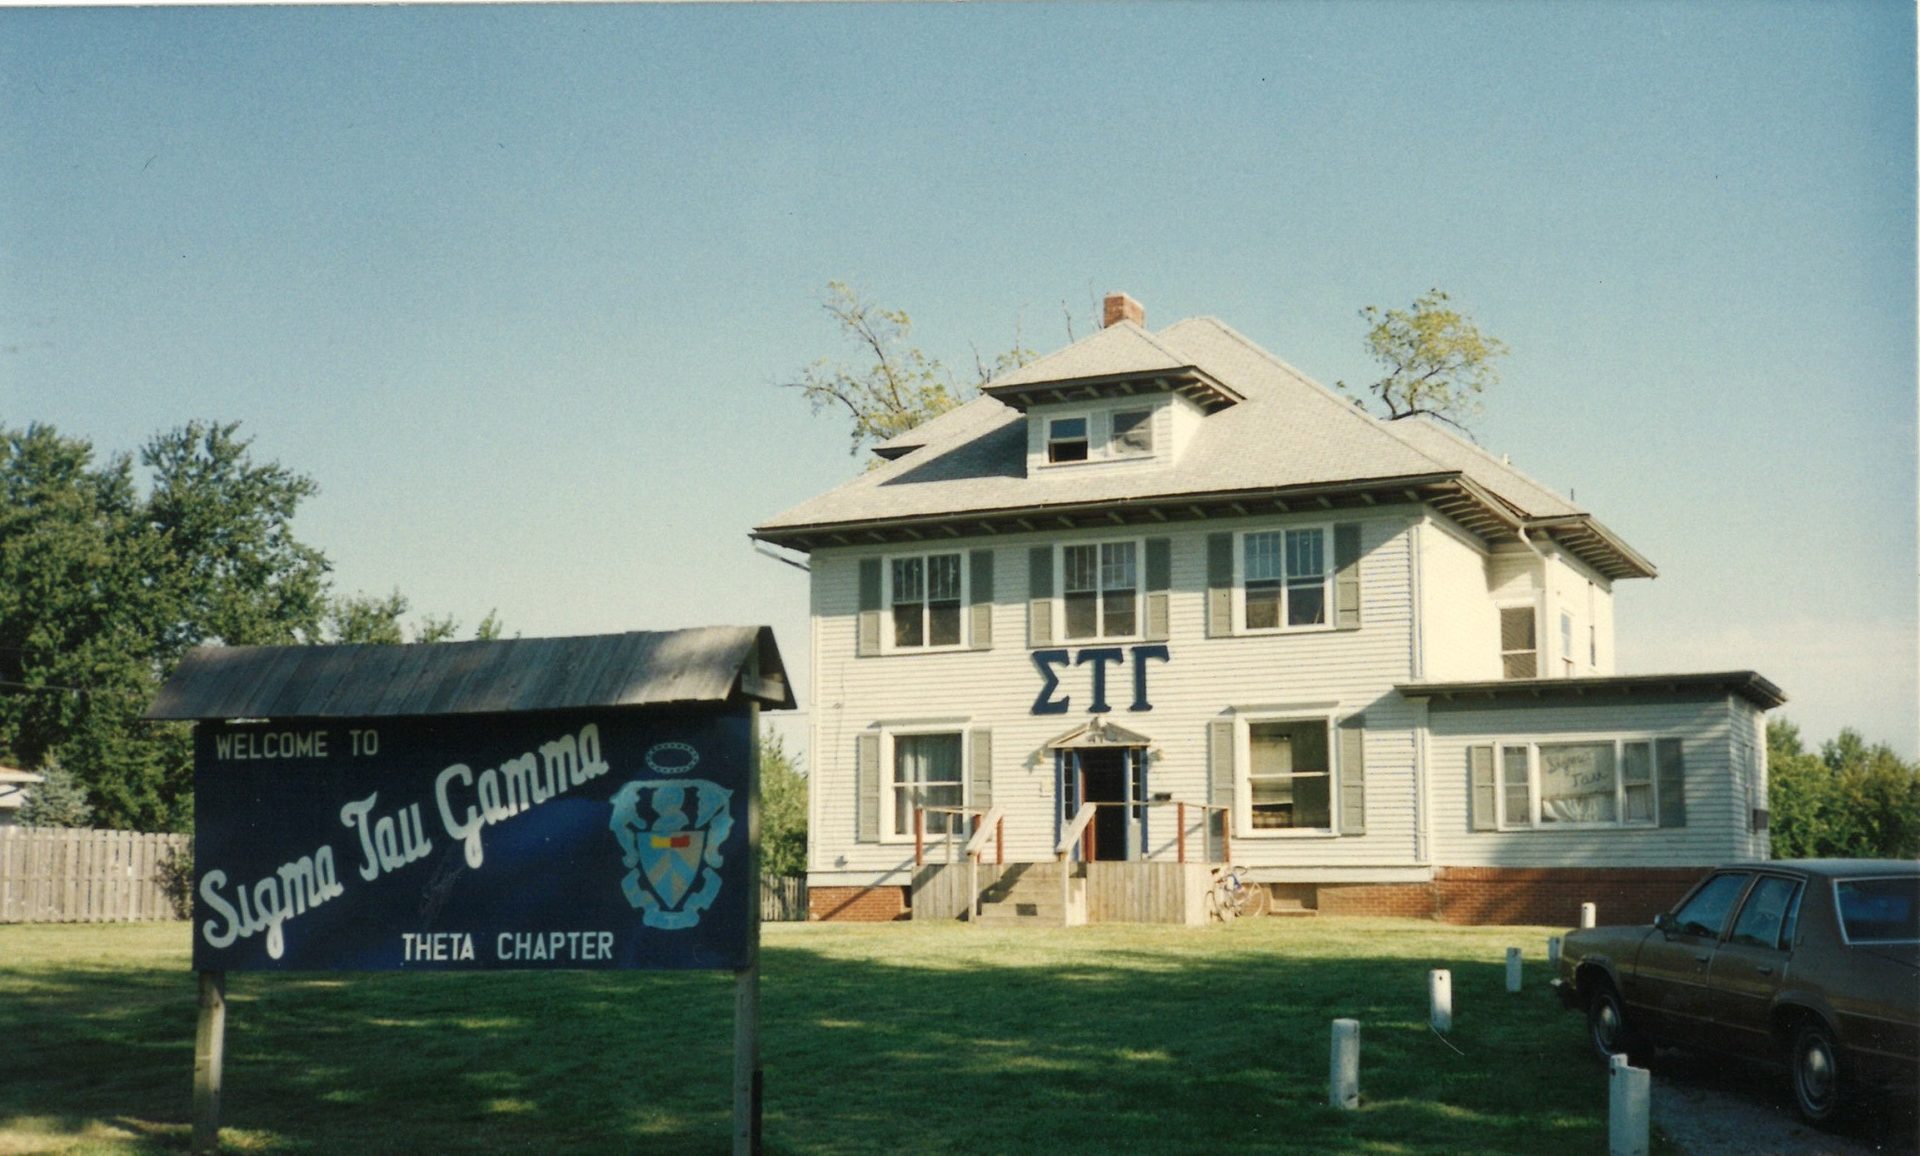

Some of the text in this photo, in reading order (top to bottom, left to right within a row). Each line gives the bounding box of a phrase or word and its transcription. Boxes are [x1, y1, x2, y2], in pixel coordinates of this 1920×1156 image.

[216, 730, 379, 760] WELCOME TO
[200, 723, 609, 960] Sigma Tau Gamma
[402, 931, 614, 961] THETA CHAPTER
